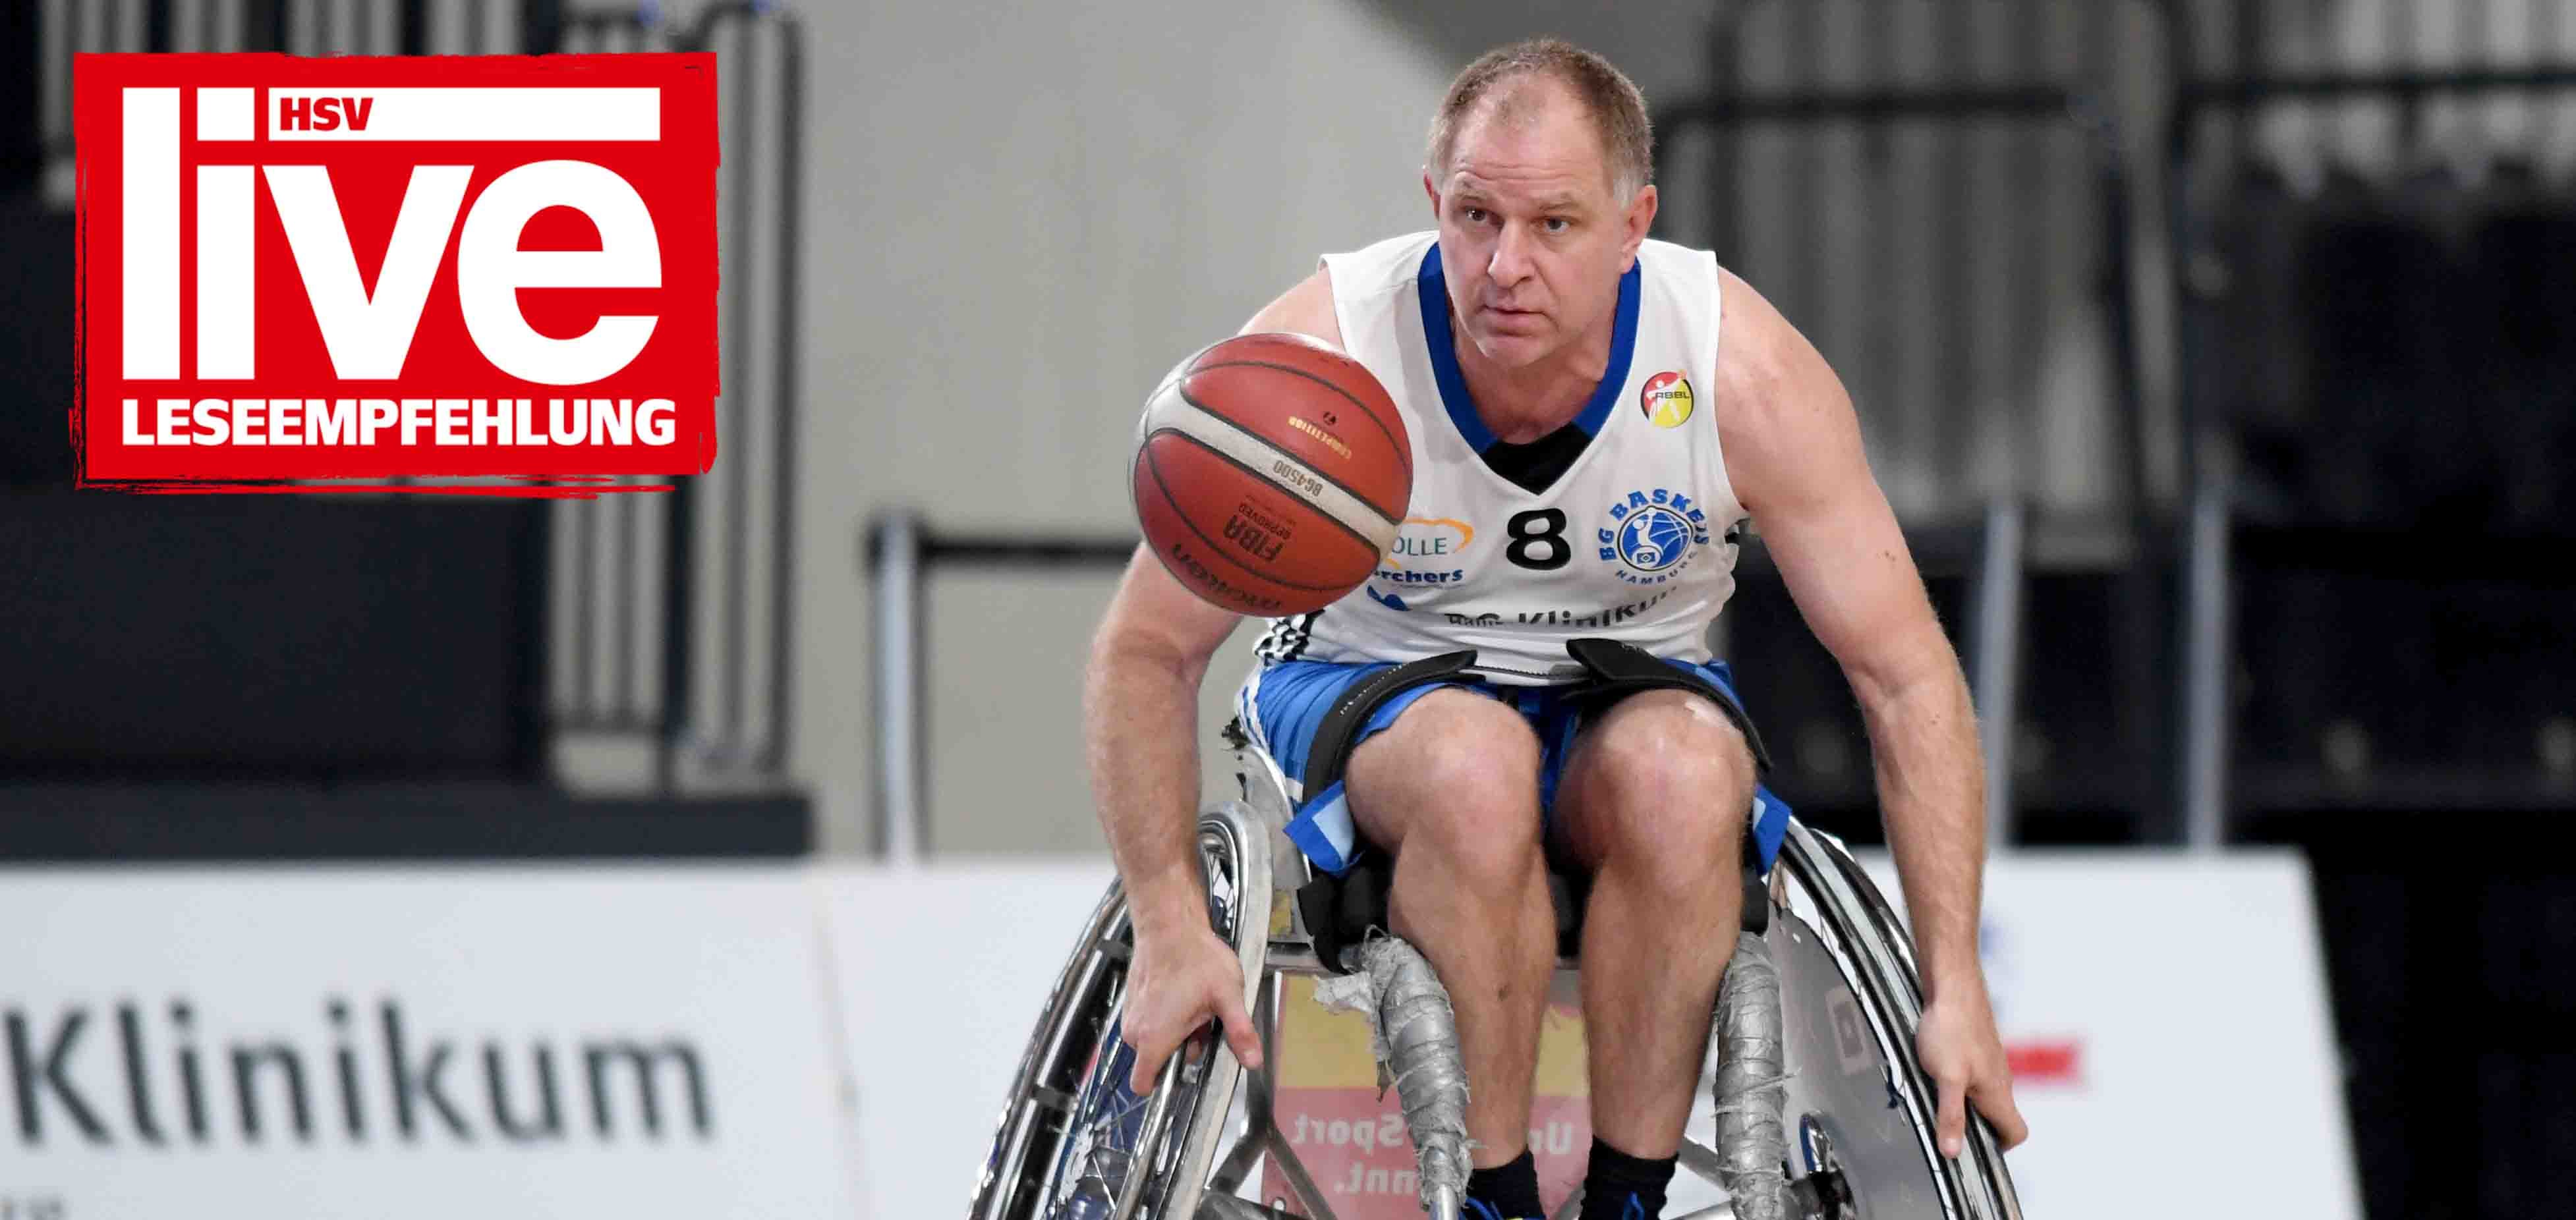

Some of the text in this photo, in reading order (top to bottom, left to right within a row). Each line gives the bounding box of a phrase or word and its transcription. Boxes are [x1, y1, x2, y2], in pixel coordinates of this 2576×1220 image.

[1273, 460, 1324, 497] BG4500
[1223, 515, 1284, 561] FIBA
[1391, 536, 1448, 556] OLLE
[1506, 508, 1571, 570] 8
[1598, 528, 1617, 561] BG
[3, 998, 716, 1148] Klinikum
